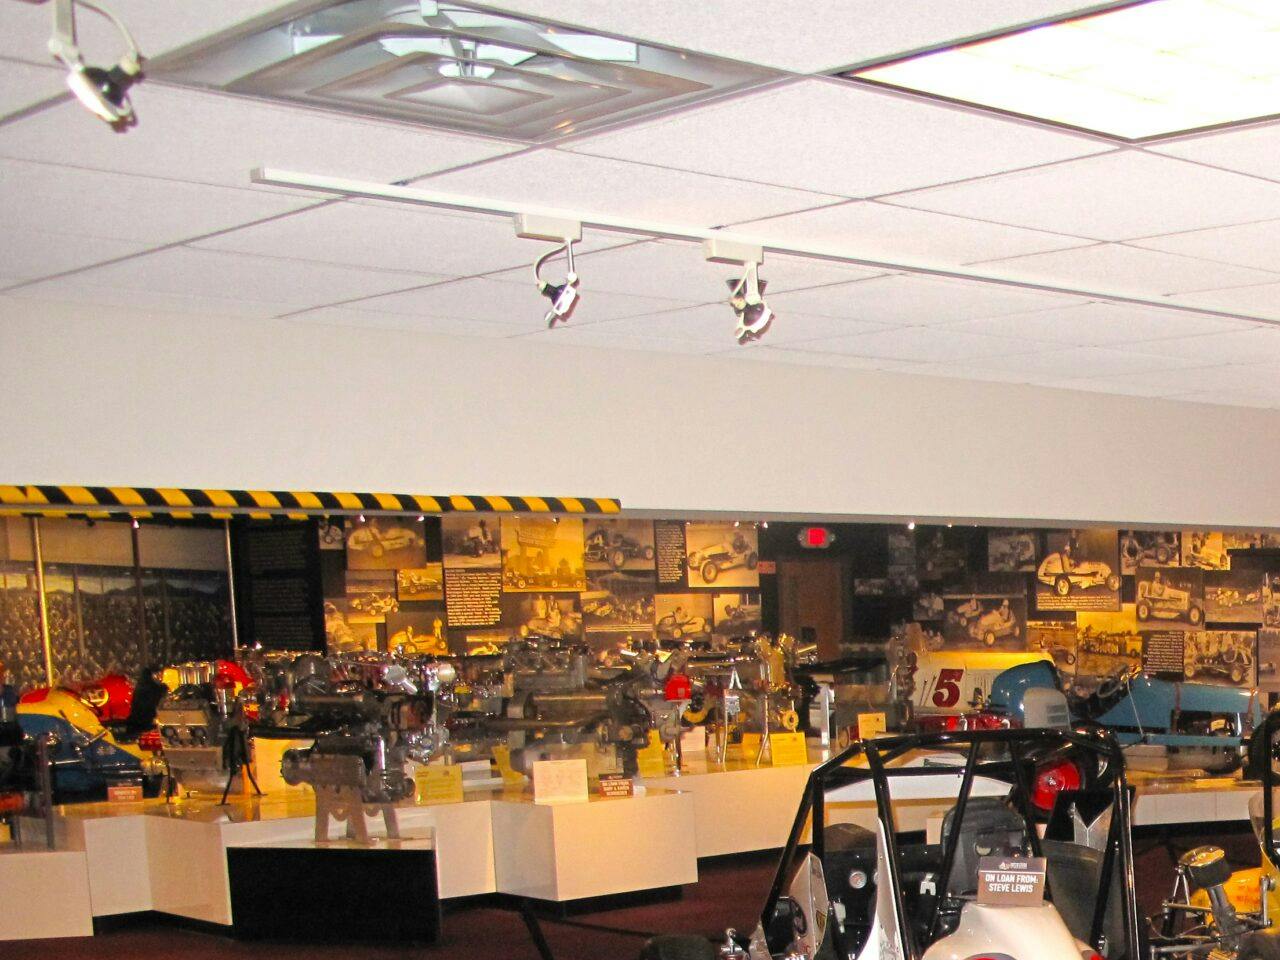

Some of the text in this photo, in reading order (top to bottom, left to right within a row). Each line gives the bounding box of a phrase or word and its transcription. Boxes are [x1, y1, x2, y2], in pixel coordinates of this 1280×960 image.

[932, 668, 964, 708] 5
[985, 873, 1039, 884] ON LOAN FROM:
[988, 883, 1034, 893] STEVE LEWIS
